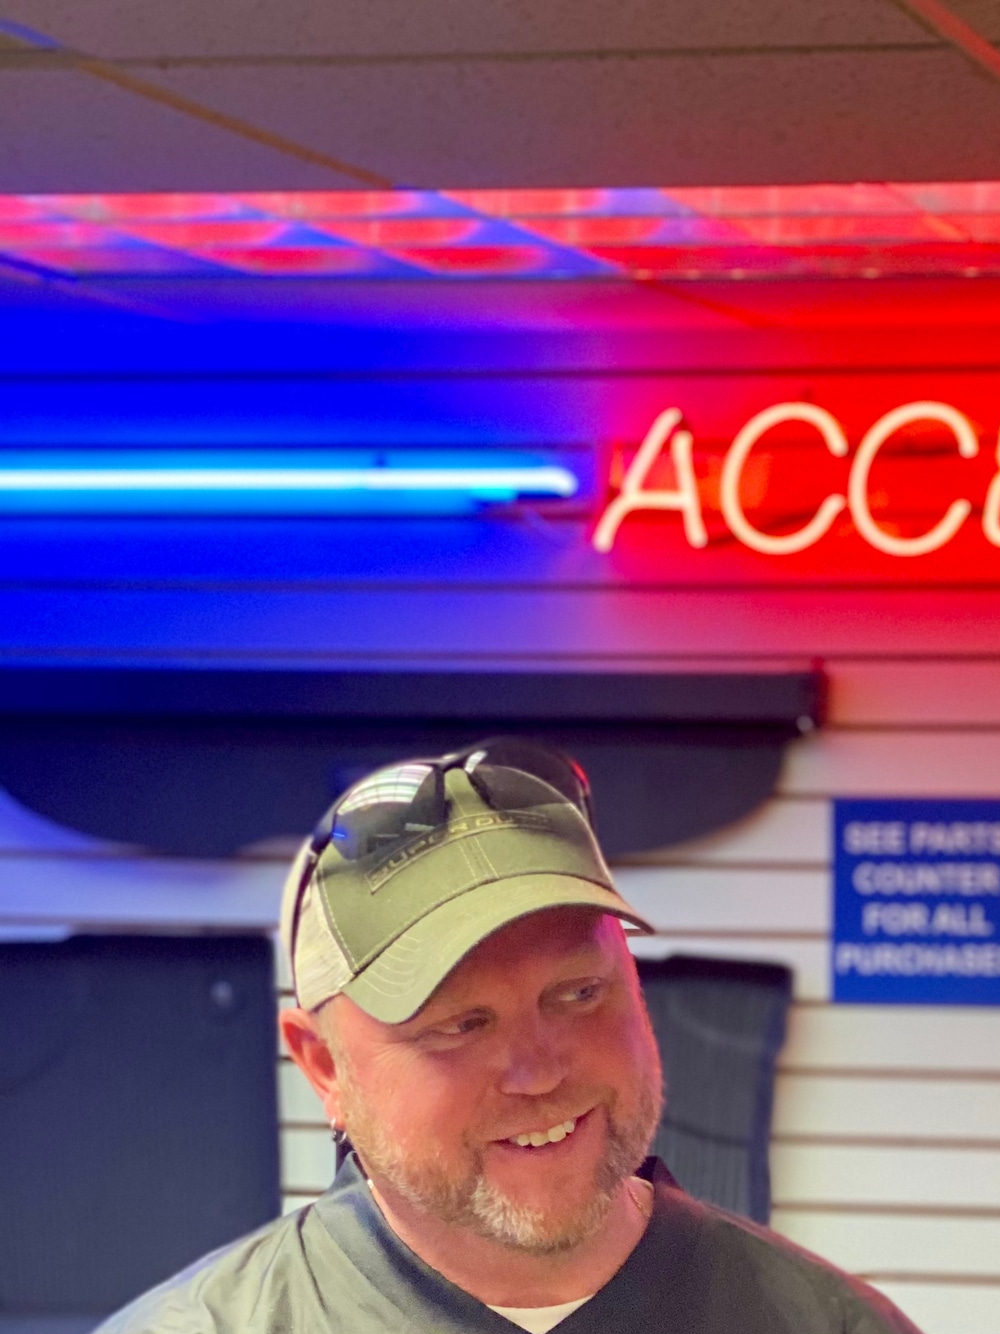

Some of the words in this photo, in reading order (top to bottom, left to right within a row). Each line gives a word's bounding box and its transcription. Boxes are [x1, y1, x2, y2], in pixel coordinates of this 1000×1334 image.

[844, 821, 905, 855] SEE
[862, 903, 930, 936] FOR
[931, 903, 994, 936] ALL
